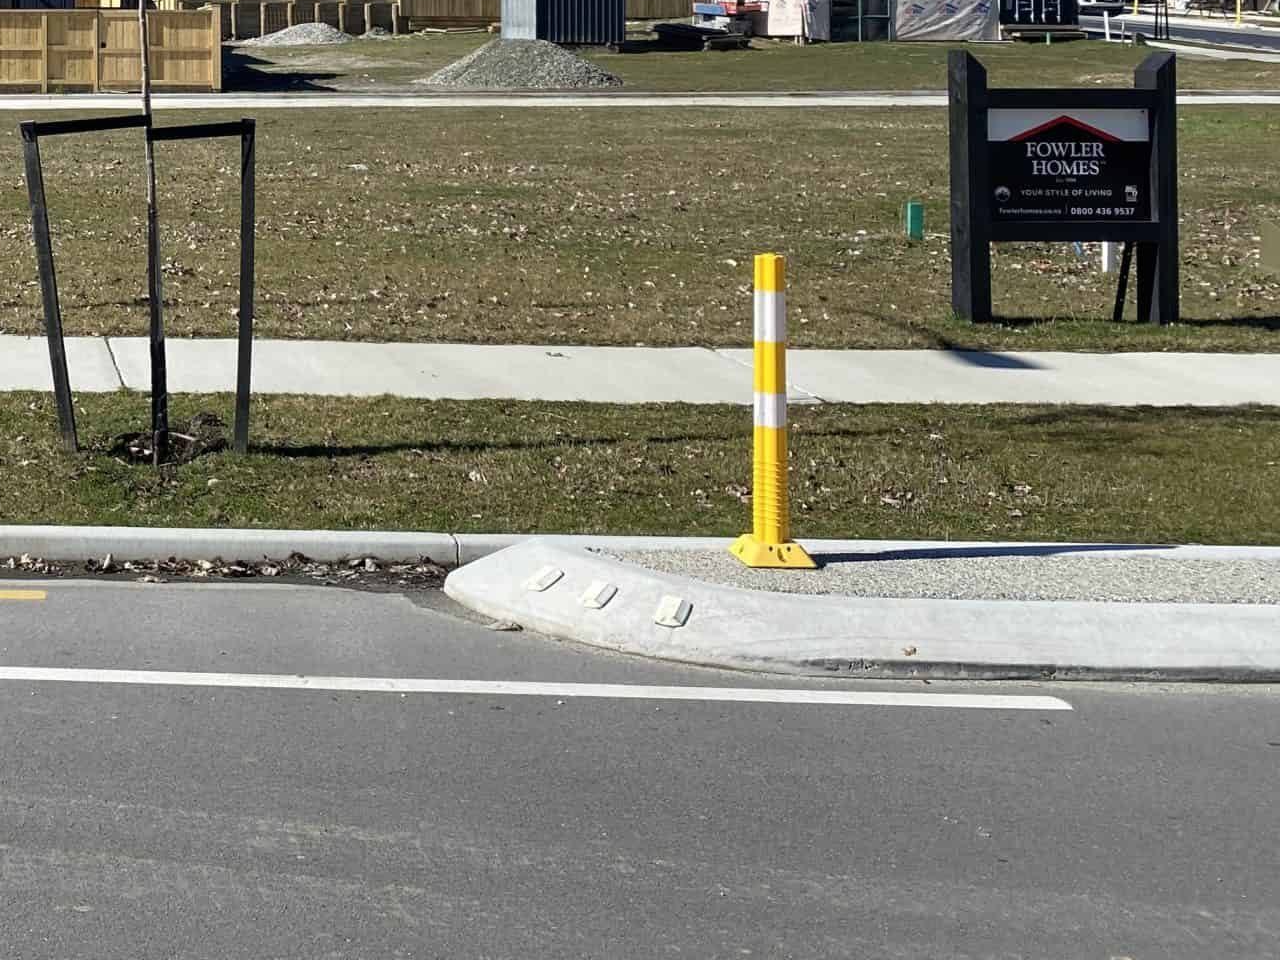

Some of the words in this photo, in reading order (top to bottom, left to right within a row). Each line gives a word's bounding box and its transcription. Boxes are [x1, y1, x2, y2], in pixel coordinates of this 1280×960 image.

[1024, 141, 1105, 157] FOWLER
[1031, 159, 1101, 176] HOMES
[1021, 189, 1043, 197] YOUR
[1045, 189, 1069, 197] STYLE
[1071, 189, 1083, 197] OF
[1084, 189, 1113, 197] LIVING
[1070, 207, 1094, 215] 0800
[1095, 207, 1112, 215] 436
[1114, 207, 1135, 216] 9537
